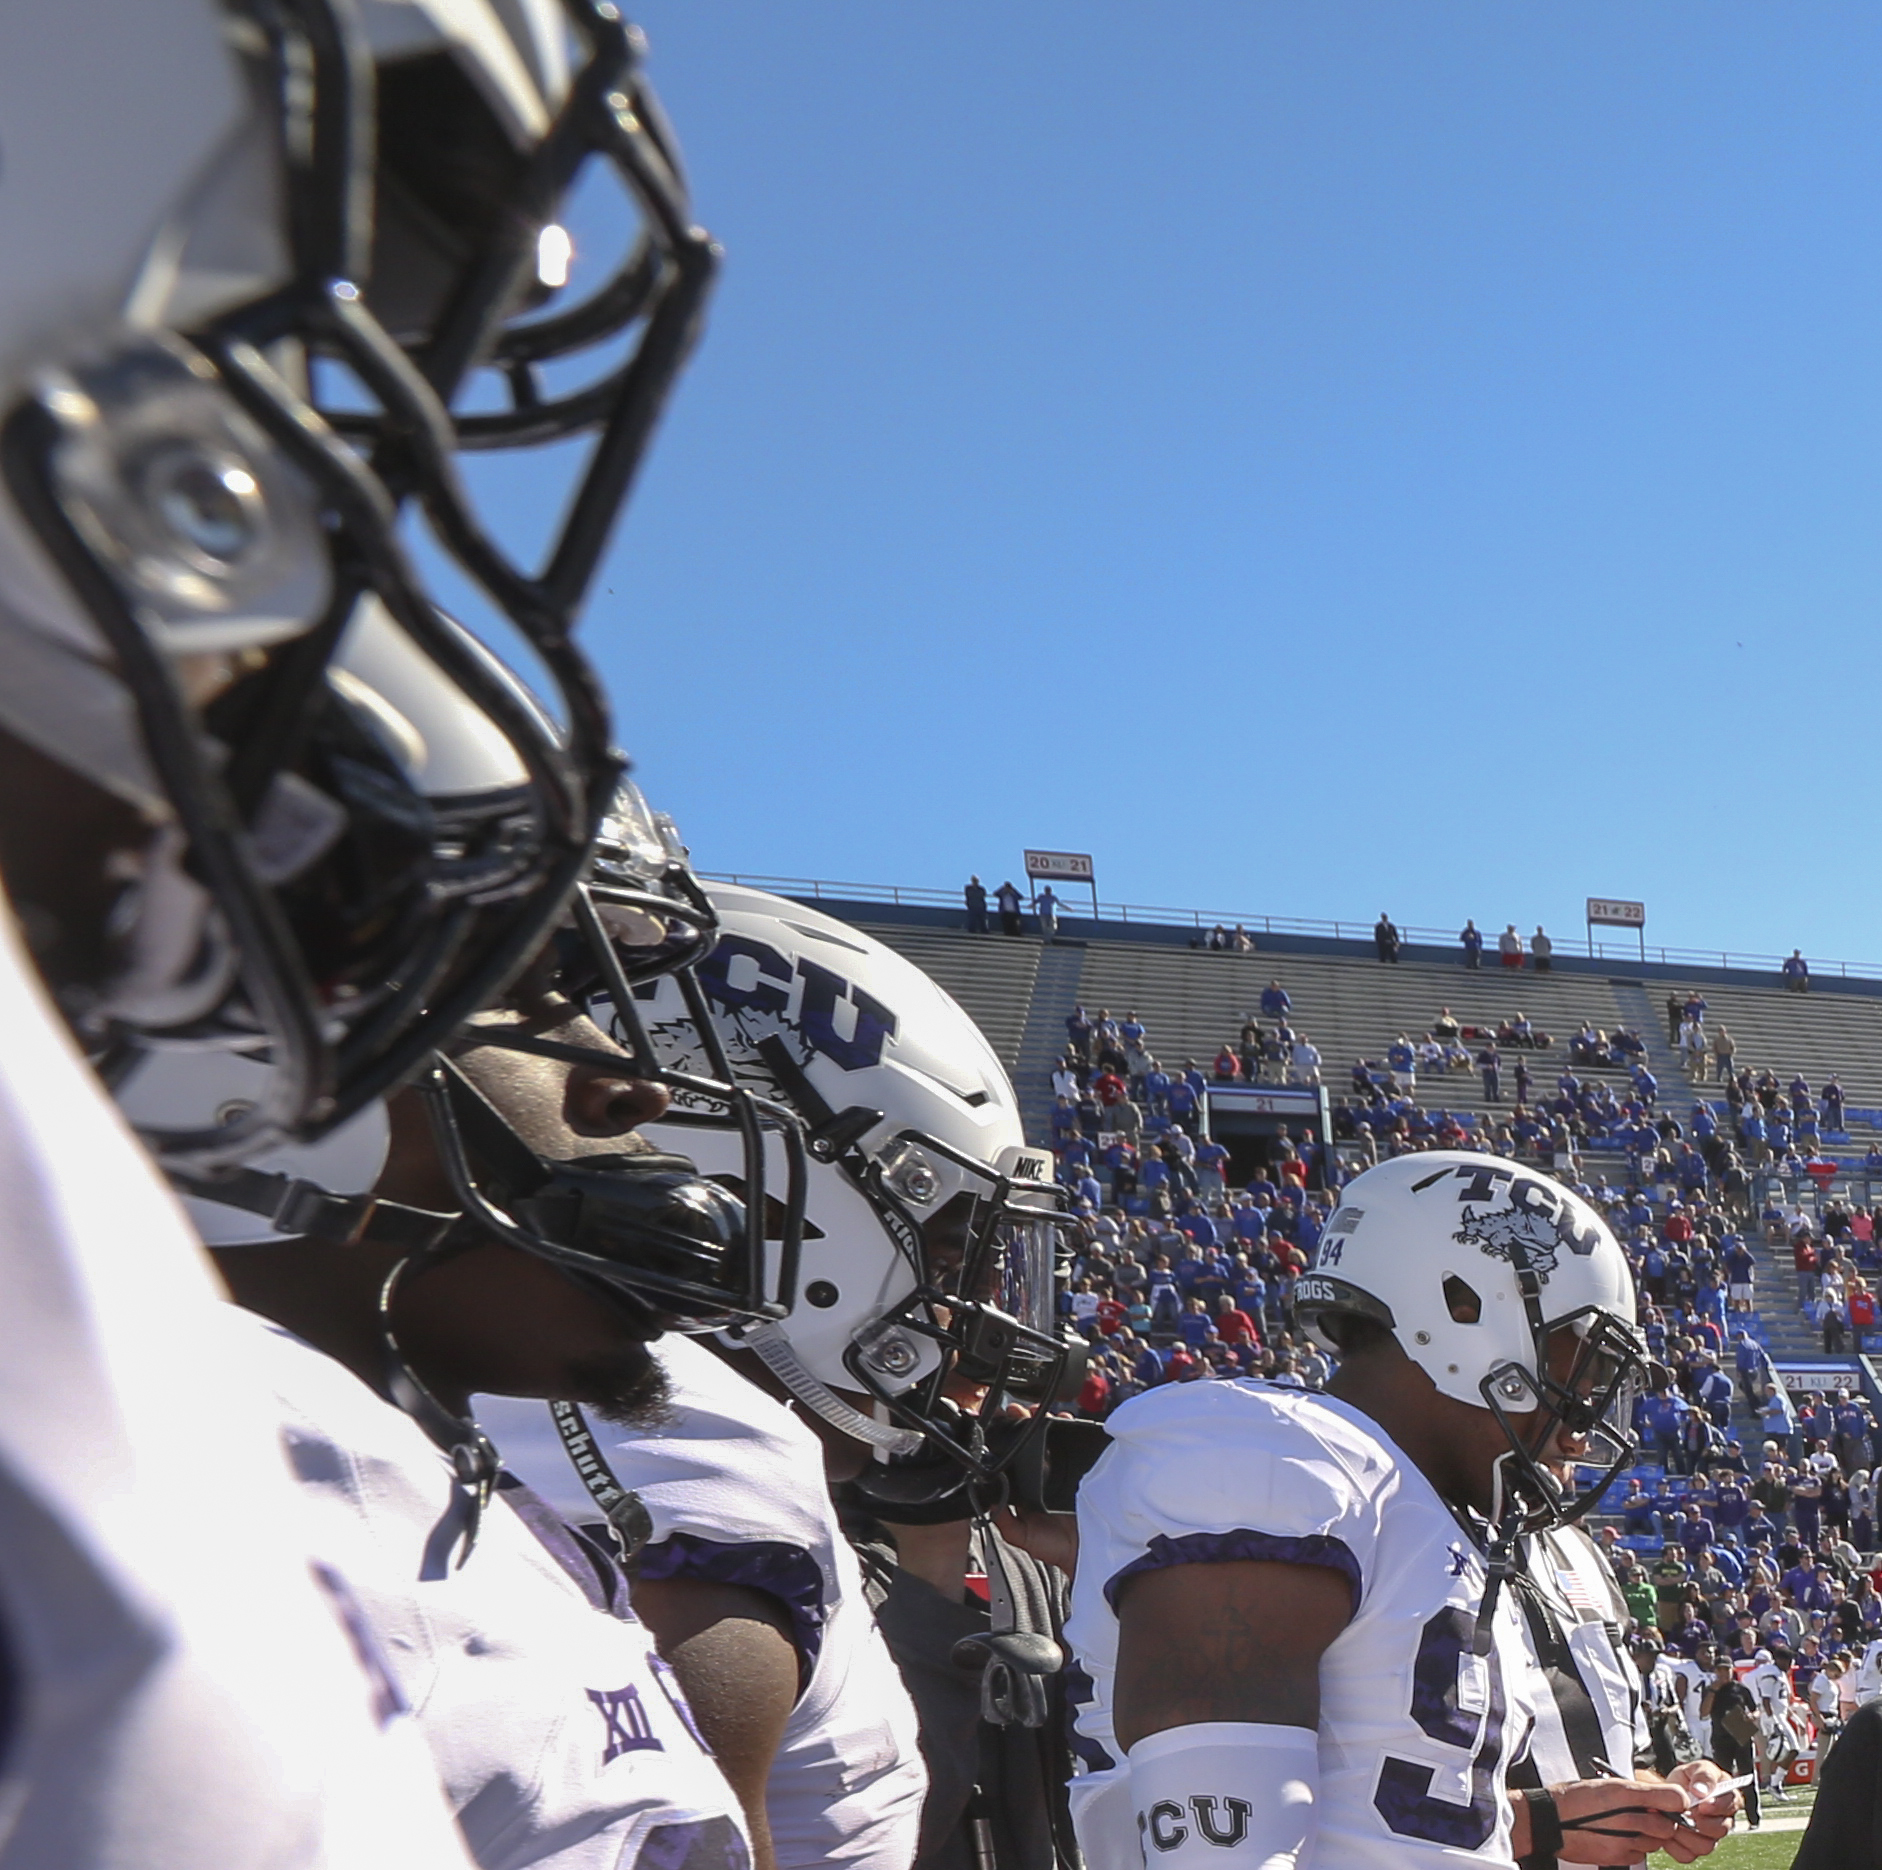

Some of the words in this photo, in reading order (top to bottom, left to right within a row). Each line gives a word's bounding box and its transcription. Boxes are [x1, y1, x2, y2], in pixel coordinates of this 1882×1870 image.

[1029, 856, 1050, 869] 20
[1070, 859, 1088, 872] 21
[1593, 903, 1608, 916] 21
[1624, 906, 1641, 919] 22
[1256, 1098, 1273, 1111] 21
[1011, 1156, 1047, 1180] NIKE
[1456, 1165, 1600, 1258] TCU
[1319, 1238, 1345, 1267] 94
[1786, 1376, 1803, 1389] 21
[1833, 1376, 1853, 1389] 22
[1372, 1602, 1520, 1853] 9
[1794, 1762, 1809, 1778] G
[1138, 1795, 1252, 1853] CU
